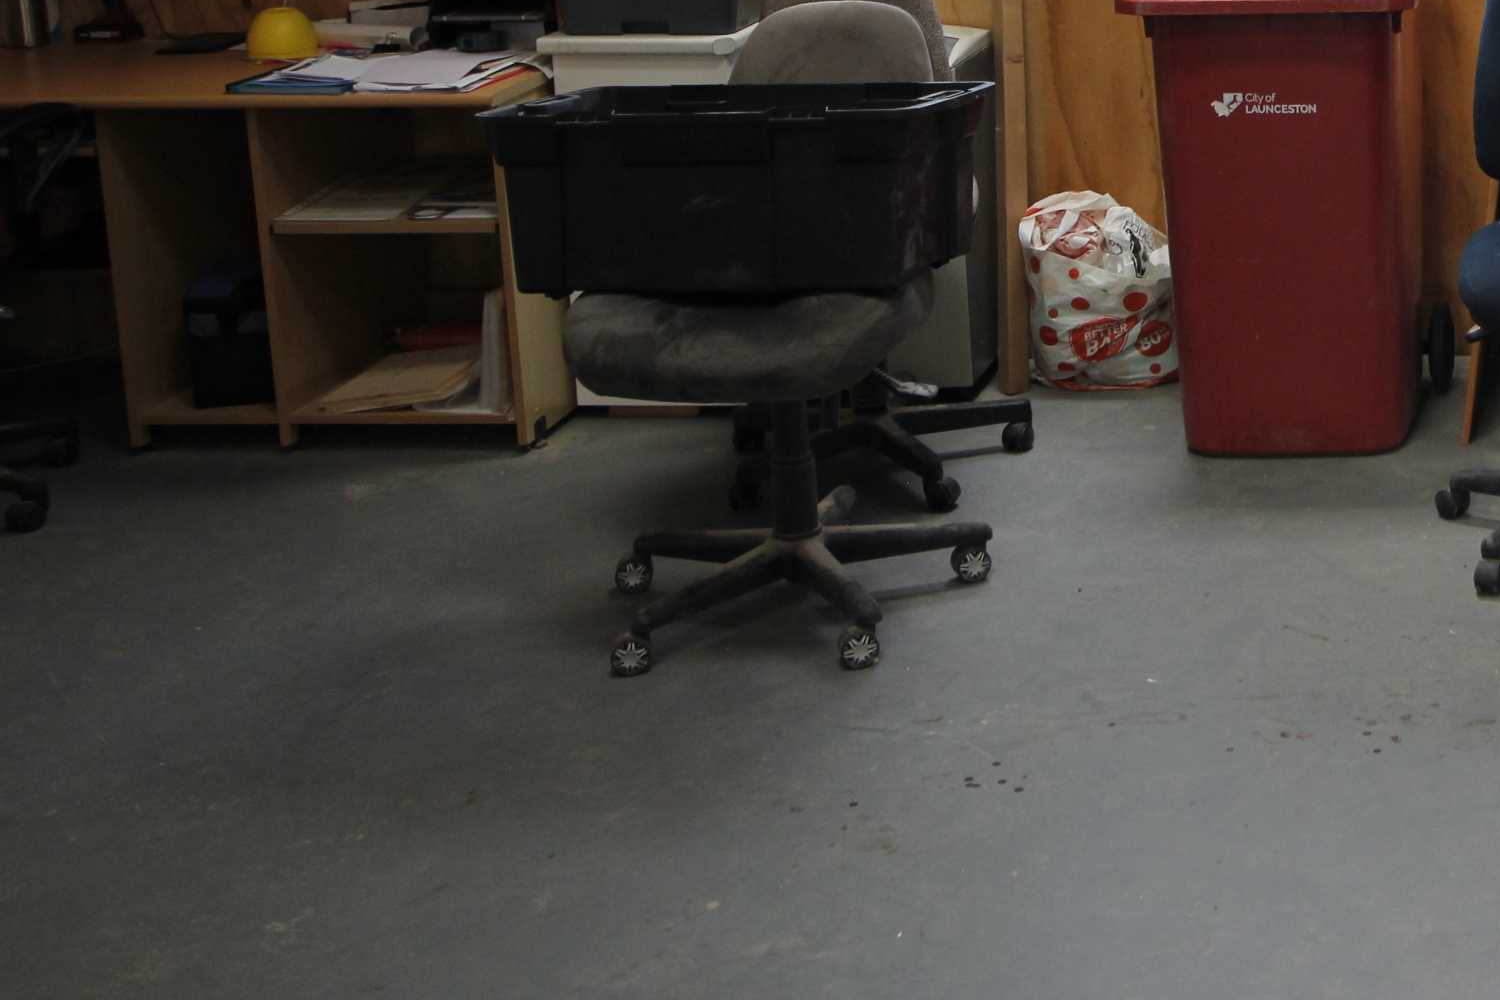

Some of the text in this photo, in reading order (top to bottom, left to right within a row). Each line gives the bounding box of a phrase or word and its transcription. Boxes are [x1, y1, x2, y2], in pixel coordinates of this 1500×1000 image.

[1244, 92, 1276, 104] City of
[1245, 104, 1317, 114] LAUNCESTON
